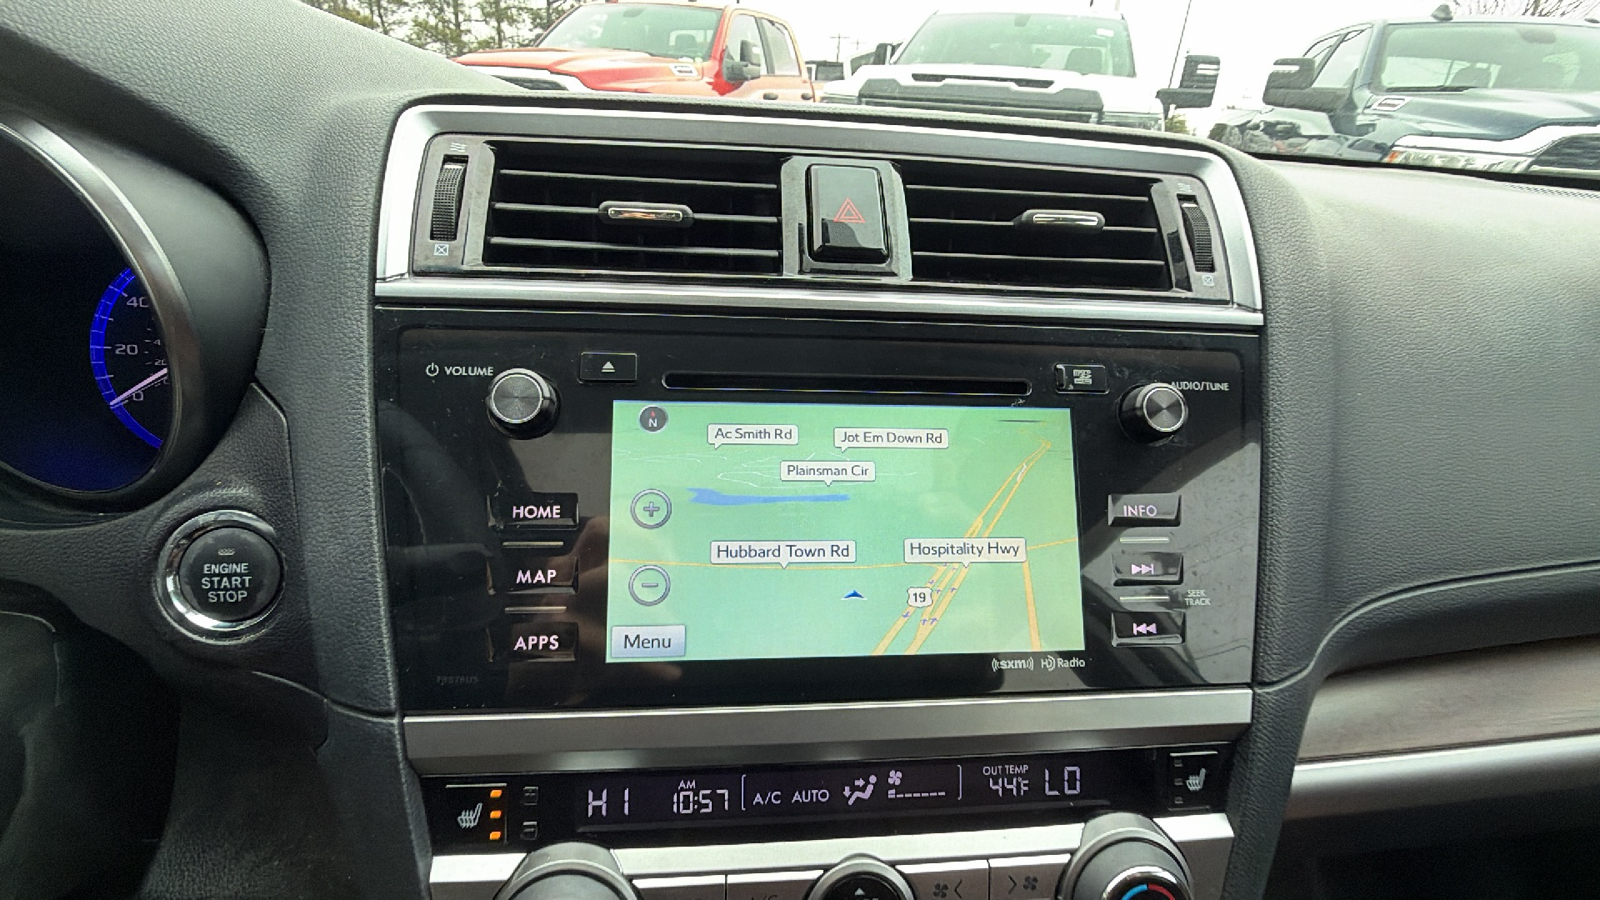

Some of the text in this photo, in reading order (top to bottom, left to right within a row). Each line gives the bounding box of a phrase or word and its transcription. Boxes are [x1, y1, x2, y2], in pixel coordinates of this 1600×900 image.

[115, 344, 139, 355] 20
[445, 366, 494, 376] VOLUME
[1171, 381, 1229, 391] AUDIO/TUNE
[648, 418, 658, 428] N
[714, 428, 792, 439] Ac Smith Rd
[841, 432, 942, 443] Jot Em Down Rd
[787, 465, 869, 476] Plainsman Cir
[512, 505, 561, 519] HOME
[1123, 504, 1158, 517] INFO
[716, 545, 850, 559] Hubbard Town Rd
[909, 541, 1020, 558] Hospitality Hwy
[203, 563, 249, 574] ENGINE
[201, 576, 252, 589] START
[516, 569, 557, 584] MAP
[208, 590, 248, 603] STOP
[913, 591, 926, 603] 19
[1187, 589, 1206, 598] SEEK
[1184, 597, 1211, 606] TRACK
[513, 635, 560, 650] APPS
[623, 634, 672, 649] Menu
[1057, 657, 1086, 668] Radio
[982, 764, 1029, 776] OUT TEMP
[678, 780, 696, 790] AM
[1045, 766, 1081, 796] LO
[673, 789, 729, 814] 10:57
[752, 789, 830, 806] A/C AUTO
